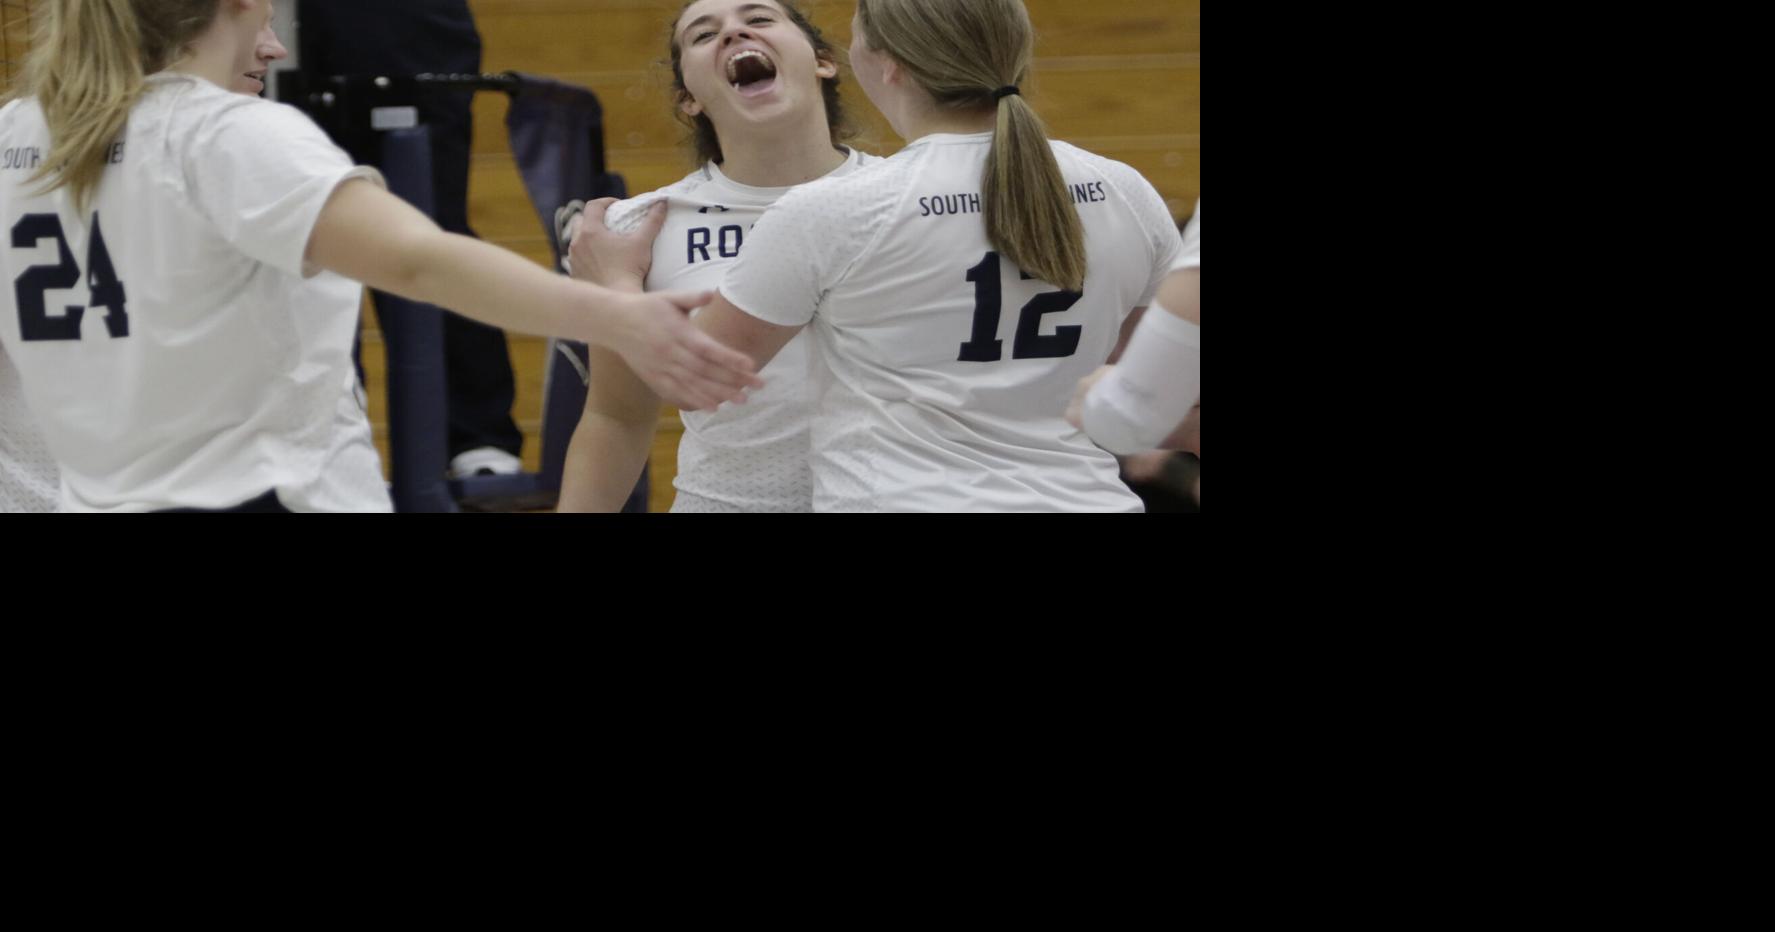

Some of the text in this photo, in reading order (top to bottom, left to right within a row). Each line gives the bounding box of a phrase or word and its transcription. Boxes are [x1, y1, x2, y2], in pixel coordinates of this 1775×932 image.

[919, 181, 1106, 216] SOUTH INES
[10, 209, 130, 341] 24
[687, 224, 754, 264] RO
[957, 251, 1084, 362] 12
